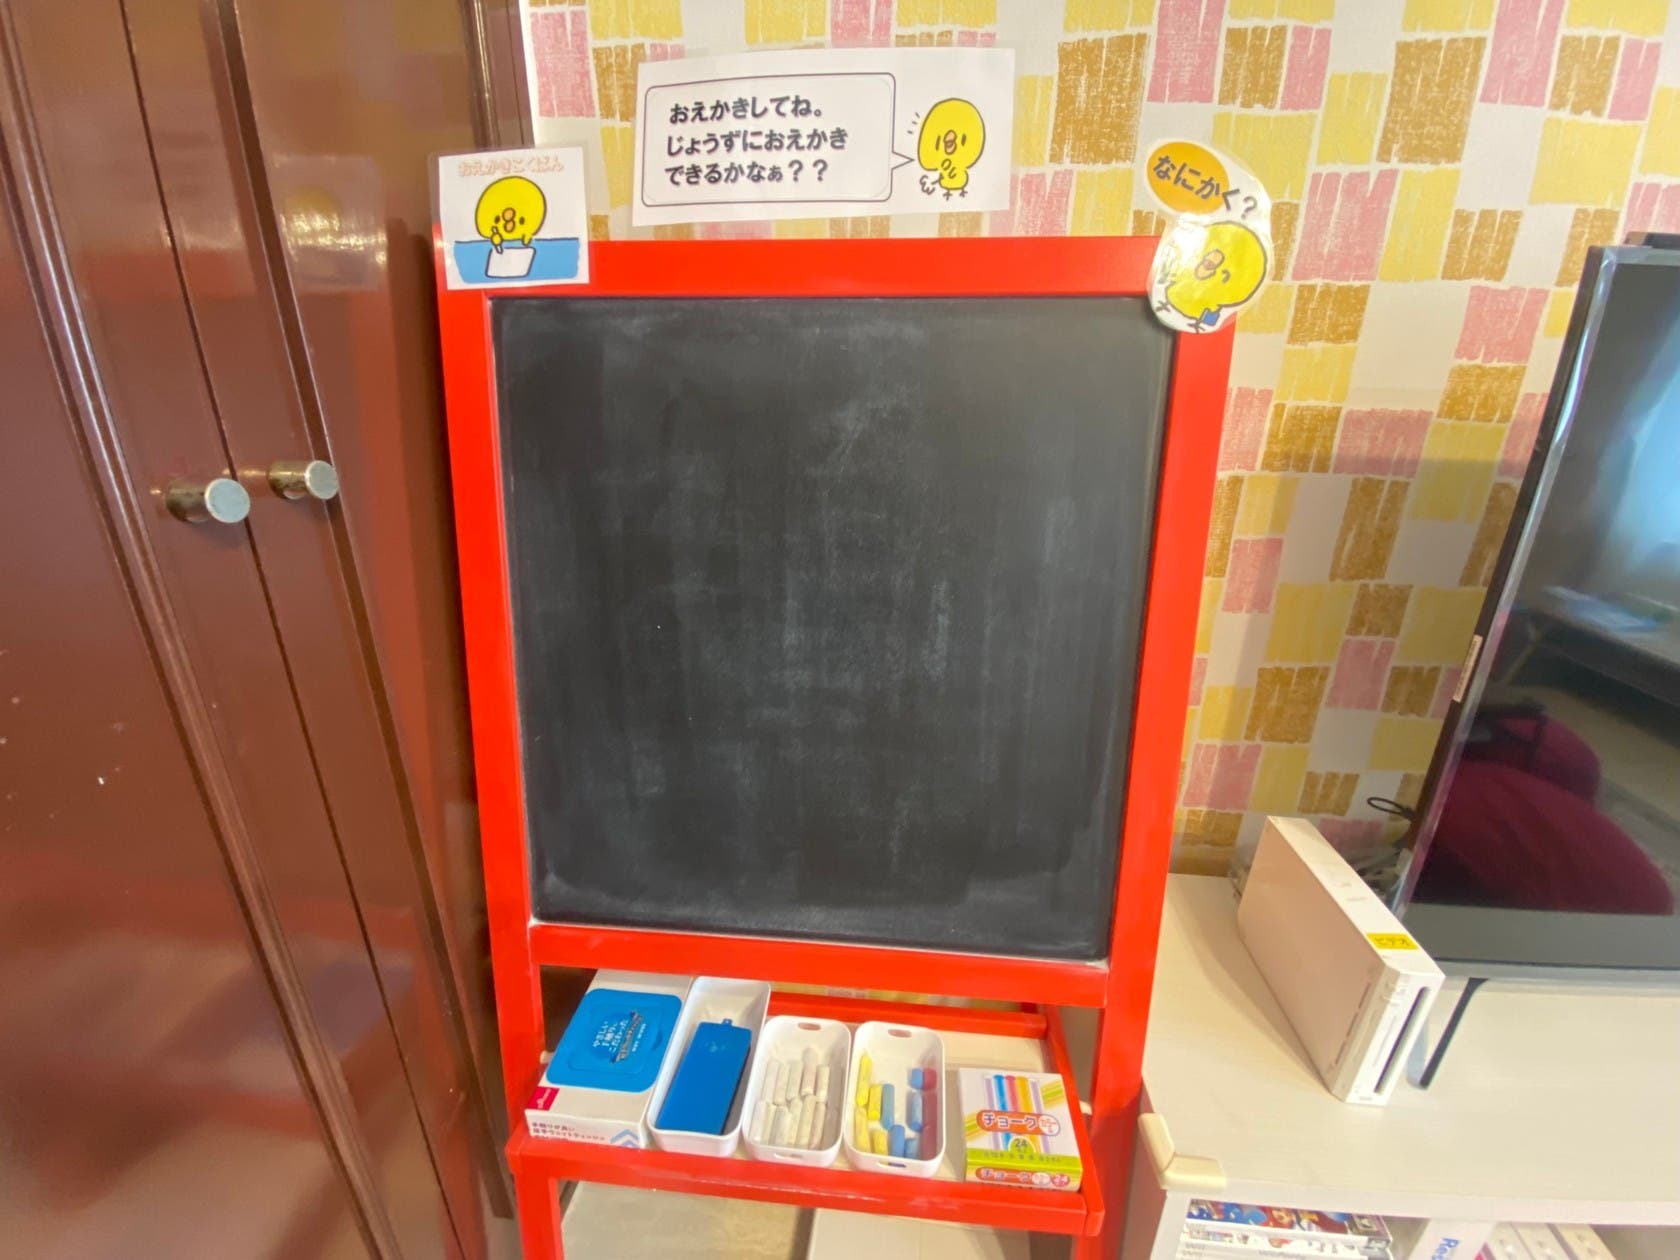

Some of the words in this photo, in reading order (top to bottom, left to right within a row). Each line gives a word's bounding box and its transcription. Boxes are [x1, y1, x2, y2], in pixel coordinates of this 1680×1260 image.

[669, 95, 822, 124] おえかきしてね。
[667, 127, 848, 157] じょうずにおえかき
[665, 159, 828, 186] できるかなぁ？？
[1153, 155, 1258, 219] なにかく?
[983, 1113, 1036, 1130] チョーク
